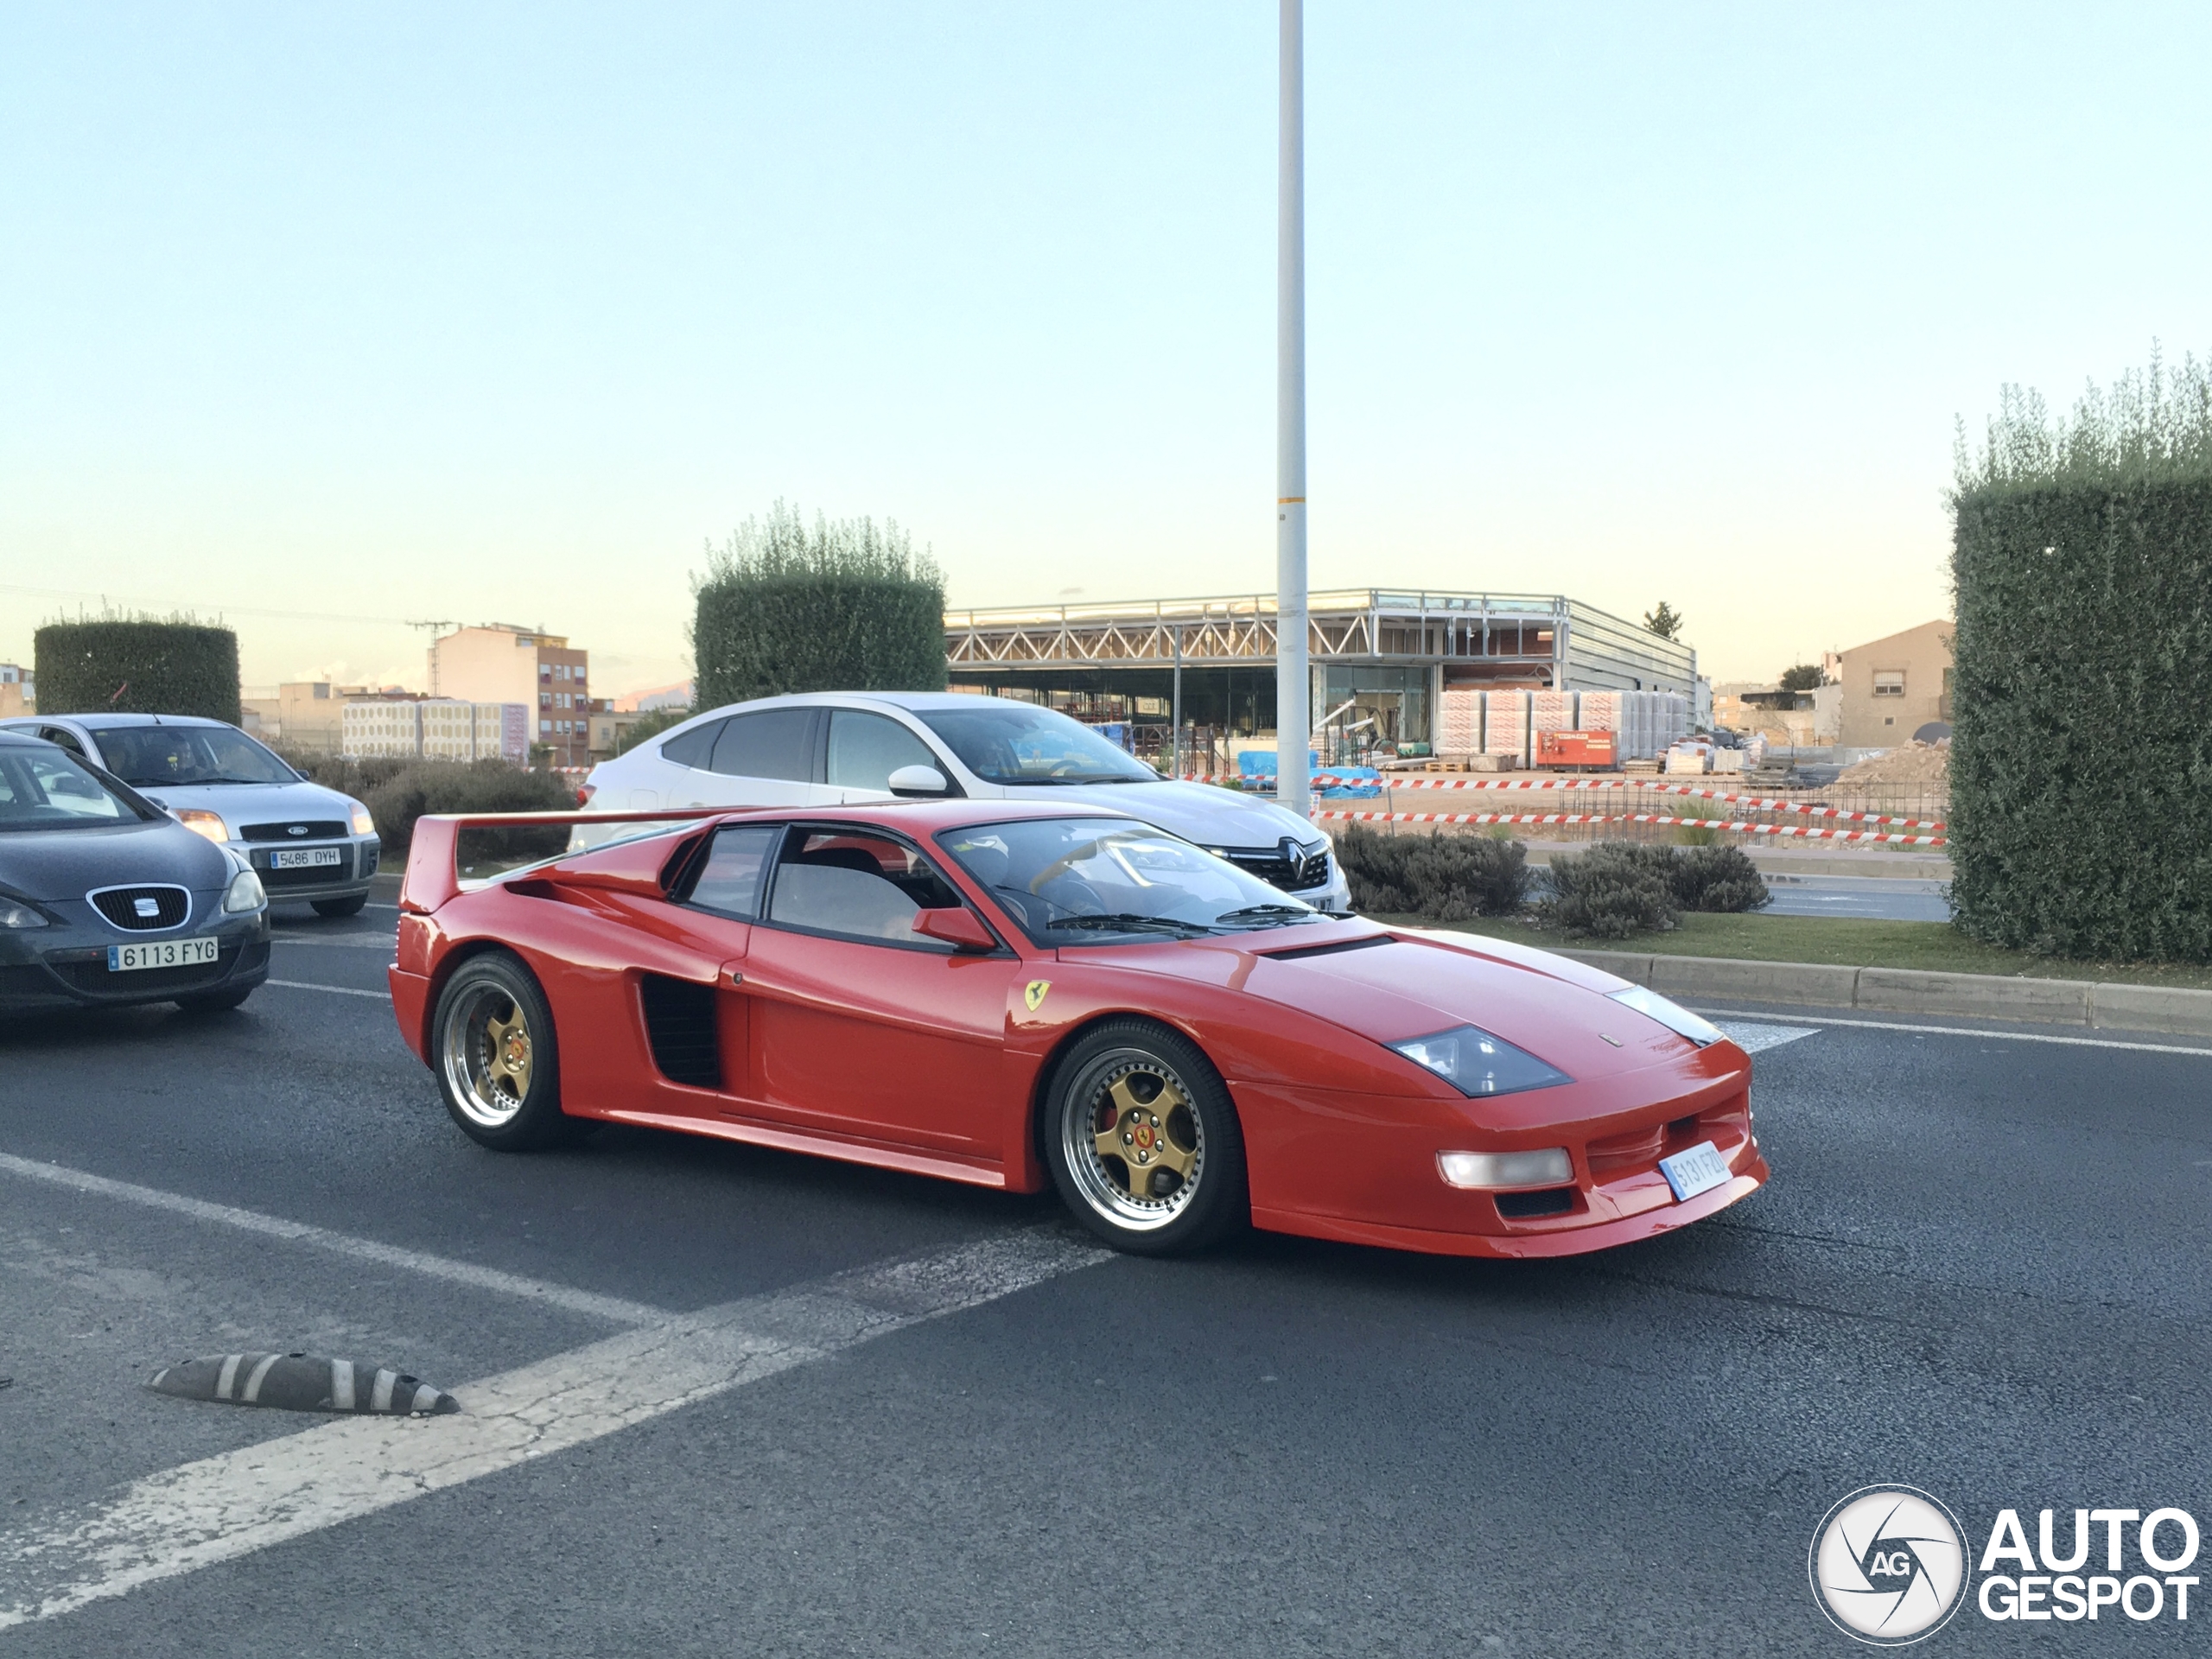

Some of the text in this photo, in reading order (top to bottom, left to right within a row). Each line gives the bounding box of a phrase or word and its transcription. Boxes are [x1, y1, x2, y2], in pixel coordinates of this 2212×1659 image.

[280, 850, 336, 866] 5486 DYH
[124, 941, 215, 967] 6113 FYG
[1672, 1149, 1726, 1188] 5131 FZD
